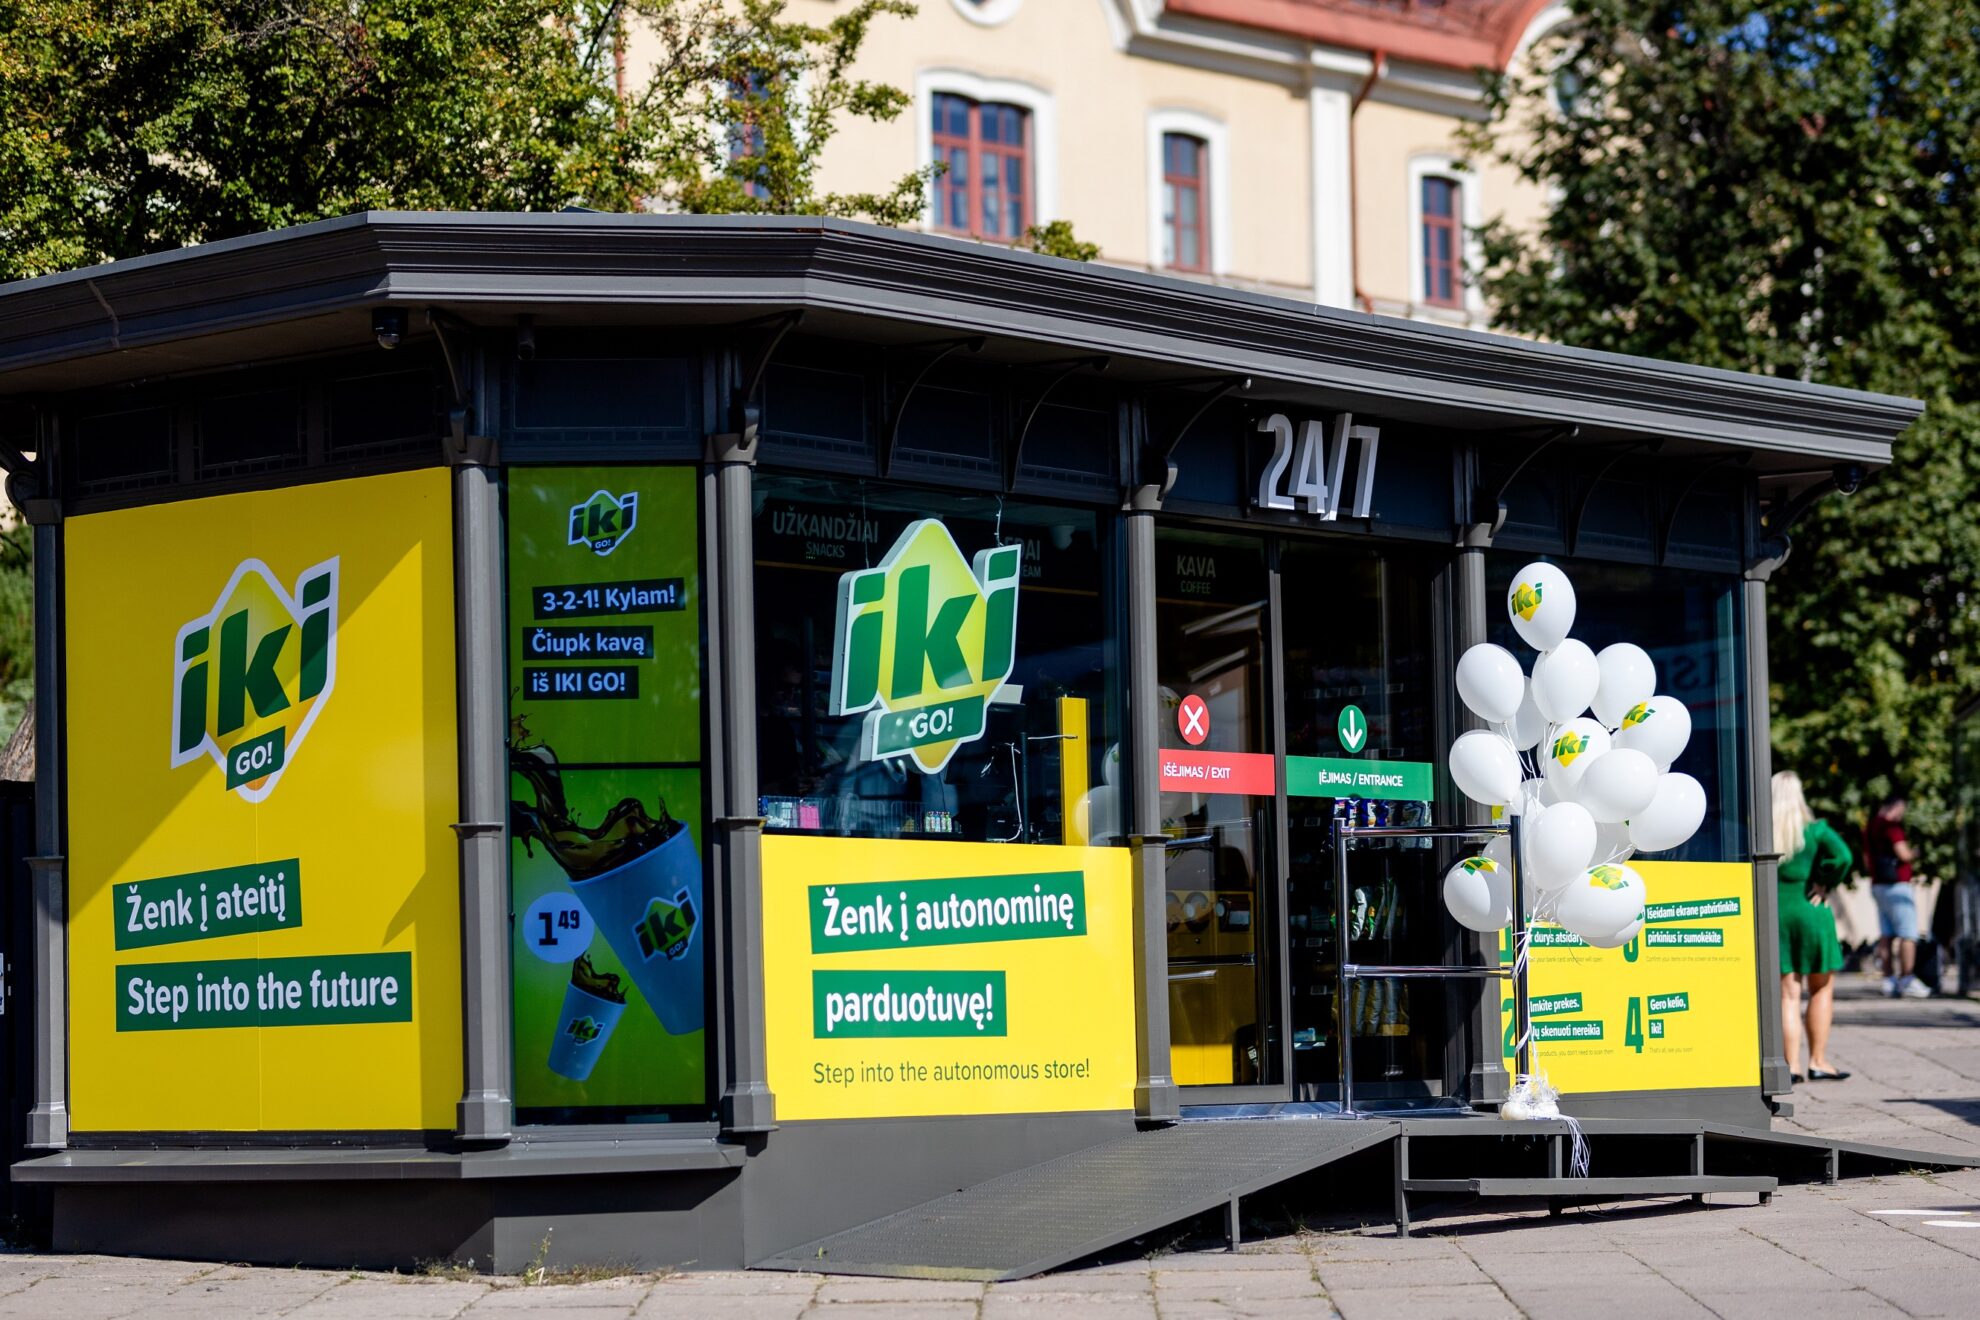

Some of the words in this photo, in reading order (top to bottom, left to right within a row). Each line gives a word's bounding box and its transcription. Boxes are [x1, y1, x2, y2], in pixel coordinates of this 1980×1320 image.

[1257, 412, 1381, 521] 24/7
[571, 496, 635, 541] iki
[773, 505, 879, 544] UŽKANDŽIAI
[595, 539, 611, 549] GO!
[806, 542, 846, 558] SNACKS
[1176, 554, 1216, 579] KAVA
[543, 588, 600, 612] 3-2-1!
[605, 585, 675, 611] Kylam!
[1180, 580, 1211, 594] COFFEE
[1511, 582, 1543, 617] iki
[532, 628, 591, 657] Čiupk
[596, 632, 645, 655] kavą
[846, 549, 1018, 710] iki
[179, 571, 331, 754] iki
[533, 673, 549, 692] iš
[555, 673, 581, 692] IKI
[588, 672, 626, 692] GO!
[911, 706, 954, 738] GO!
[235, 741, 273, 775] GO!
[1552, 735, 1590, 760] iki
[1163, 762, 1203, 778] IŠĖJIMAS
[1211, 767, 1231, 779] EXIT
[1319, 769, 1351, 785] ĮĖJIMAS
[1358, 774, 1403, 787] ENTRANCE
[126, 884, 194, 933] Ženk
[200, 883, 208, 932] į
[216, 872, 286, 922] ateitį
[822, 886, 894, 937] Ženk
[900, 891, 909, 942] į
[915, 884, 1074, 931] autonominę
[1676, 905, 1699, 917] ekrane
[635, 889, 696, 958] iki
[1534, 931, 1554, 945] durys
[1648, 931, 1676, 946] pirkinius
[1677, 931, 1683, 943] ir
[128, 977, 189, 1023] Step
[197, 972, 250, 1012] into
[257, 971, 302, 1010] the
[309, 970, 398, 1008] future
[826, 983, 993, 1032] parduotuvę!
[1554, 997, 1580, 1013] prekes.
[1650, 998, 1666, 1010] Gero
[1667, 995, 1686, 1009] kelio,
[1540, 1023, 1571, 1037] skenuoti
[1572, 1023, 1601, 1036] nereikia
[1625, 997, 1644, 1053] 4
[813, 1062, 854, 1088] Step
[861, 1060, 894, 1083] into
[900, 1061, 928, 1082] the
[933, 1061, 1039, 1081] autonomous
[1044, 1058, 1090, 1078] store!
